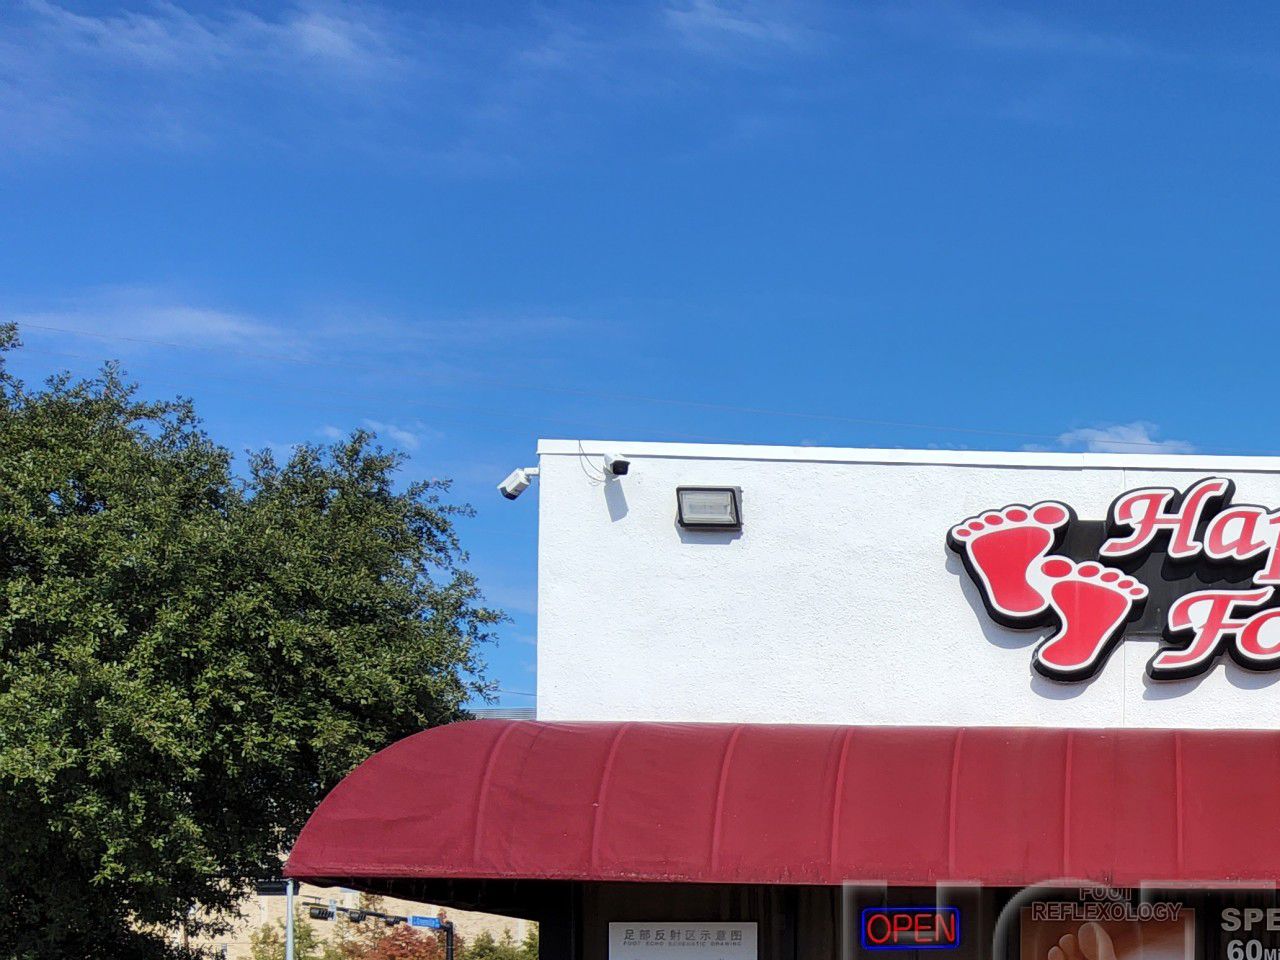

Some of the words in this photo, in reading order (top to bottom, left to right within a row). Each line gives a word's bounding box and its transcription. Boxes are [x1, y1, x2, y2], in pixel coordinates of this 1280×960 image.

[1031, 902, 1183, 921] REFLEXOLOGY
[624, 929, 742, 941] 足部反射区示意图
[866, 912, 956, 944] OPEN
